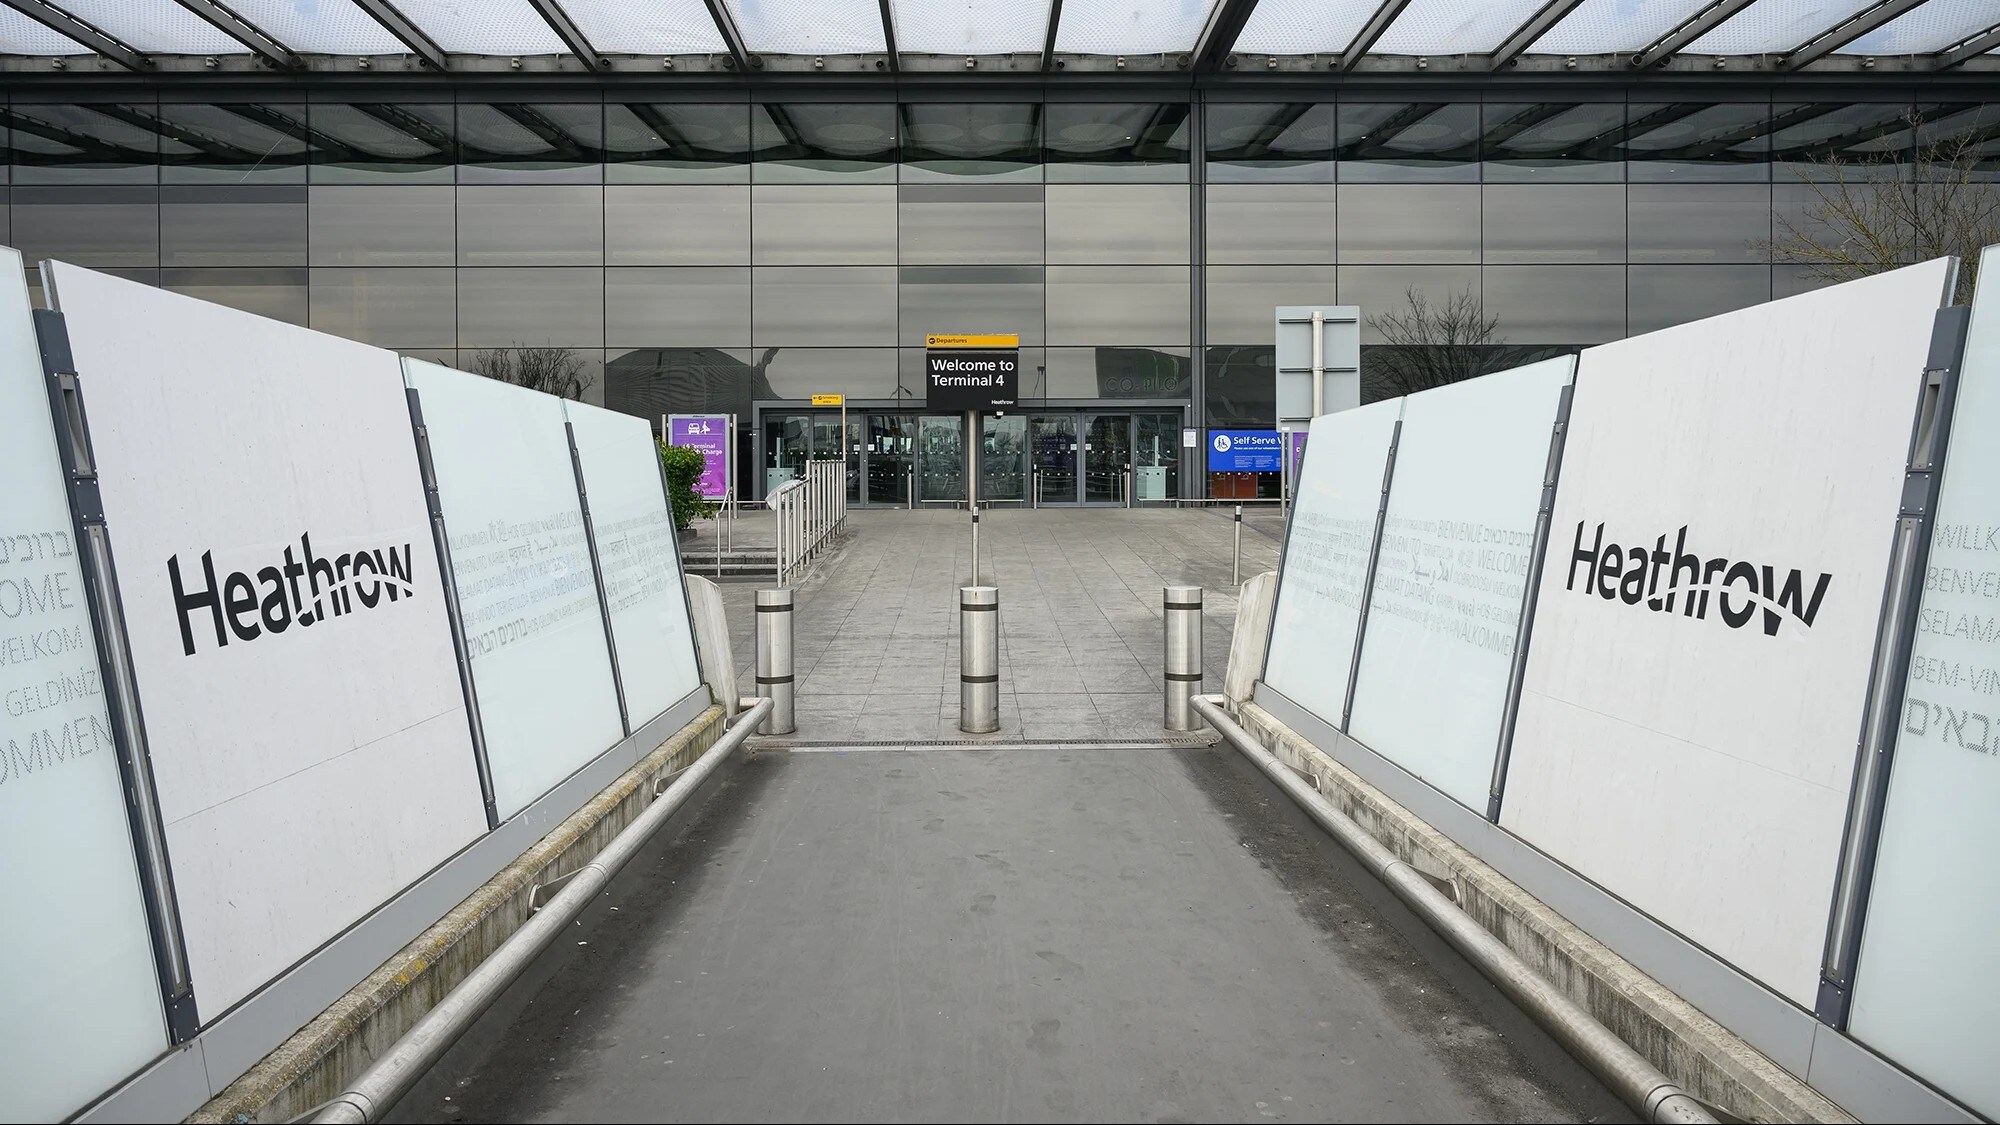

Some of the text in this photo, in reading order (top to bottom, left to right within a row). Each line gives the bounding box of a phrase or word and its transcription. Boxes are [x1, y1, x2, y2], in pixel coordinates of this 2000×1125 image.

[931, 359, 1014, 371] Welcome to
[931, 374, 1005, 386] Terminal 4
[1233, 436, 1251, 445] Self
[1252, 436, 1276, 445] Serve
[1438, 519, 1483, 543] BIENVENUE
[1477, 548, 1529, 576] WELCOME
[1566, 520, 1832, 636] Heathrow
[1926, 567, 2000, 598] BENVE
[167, 531, 413, 656] Heathrow
